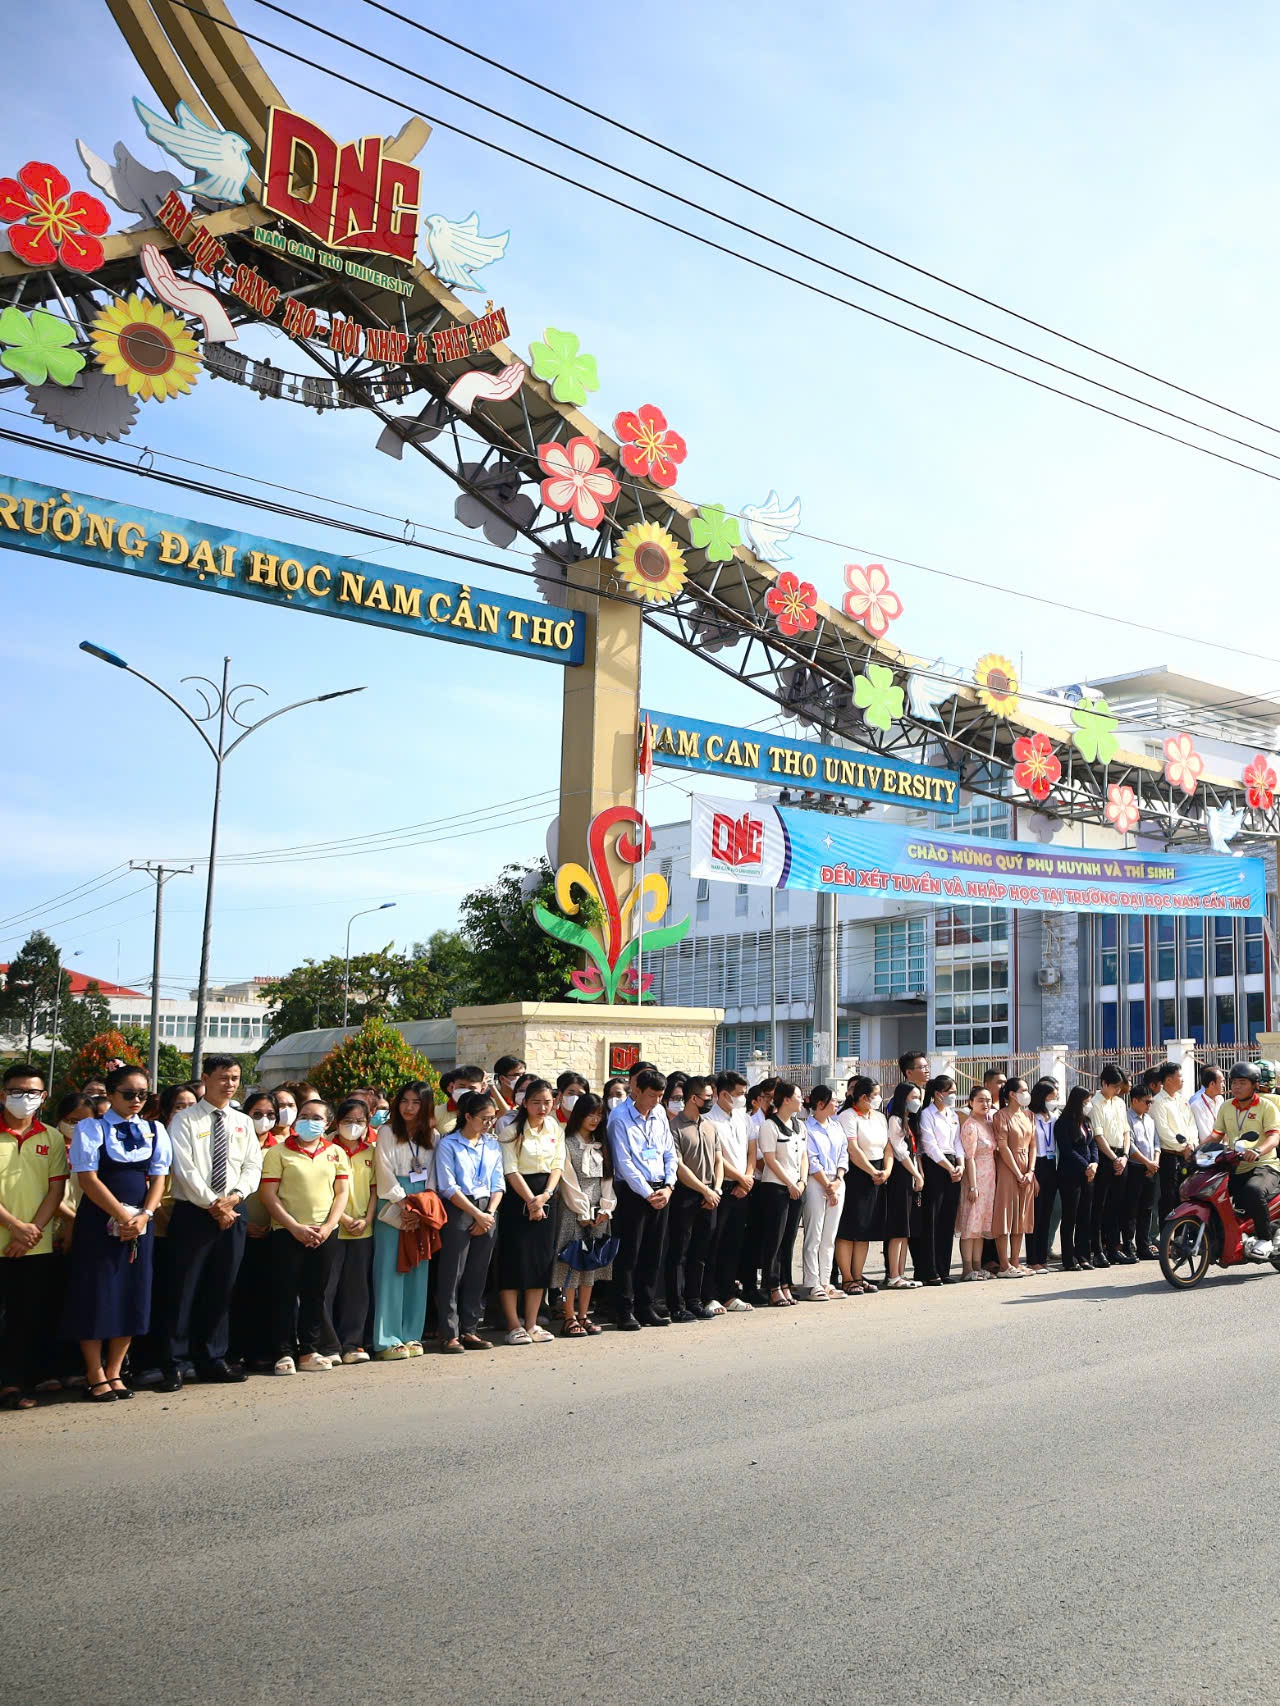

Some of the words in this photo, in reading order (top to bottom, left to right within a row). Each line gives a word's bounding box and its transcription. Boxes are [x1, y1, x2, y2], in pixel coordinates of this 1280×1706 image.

[155, 190, 198, 241] TRÍ
[231, 263, 280, 317] SÁNG
[282, 296, 317, 339] TẠO
[330, 316, 362, 361] HỘI
[367, 325, 408, 371] NHẬP
[416, 333, 428, 364] &
[433, 321, 470, 363] PHÁT
[254, 226, 286, 250] NAM
[288, 240, 315, 262] CAN
[319, 250, 343, 271] THO
[345, 260, 415, 297] UNIVERSITY
[159, 530, 237, 580] ĐẠI
[247, 551, 331, 599] HỌC
[340, 571, 423, 618] NAM
[428, 584, 500, 634] CẦN
[507, 610, 575, 650] THƠ
[706, 735, 760, 769] CAN
[768, 747, 817, 778] THO
[824, 757, 957, 803] UNIVERSITY
[821, 862, 855, 886] ĐẾN
[858, 867, 889, 889] XÉT
[891, 871, 941, 894] TUYỂN
[943, 876, 965, 896] VÀ
[967, 879, 1007, 902] NHẬP
[1009, 885, 1039, 905] HỌC
[1041, 887, 1064, 907] TẠI
[1065, 888, 1118, 906] TRƯỜNG
[1120, 892, 1143, 909] ĐẠI
[1145, 894, 1171, 910] HỌC
[1172, 895, 1200, 908] NAM
[1228, 895, 1251, 910] THƠ
[907, 843, 948, 862] CHÀO
[952, 848, 993, 867] MỪNG
[996, 854, 1024, 871] QUÝ
[1027, 858, 1053, 875] PHỤ
[1057, 861, 1100, 876] HUYNH
[1104, 861, 1122, 877] VÀ
[1124, 864, 1145, 879] THÍ
[1148, 867, 1175, 880] SINH
